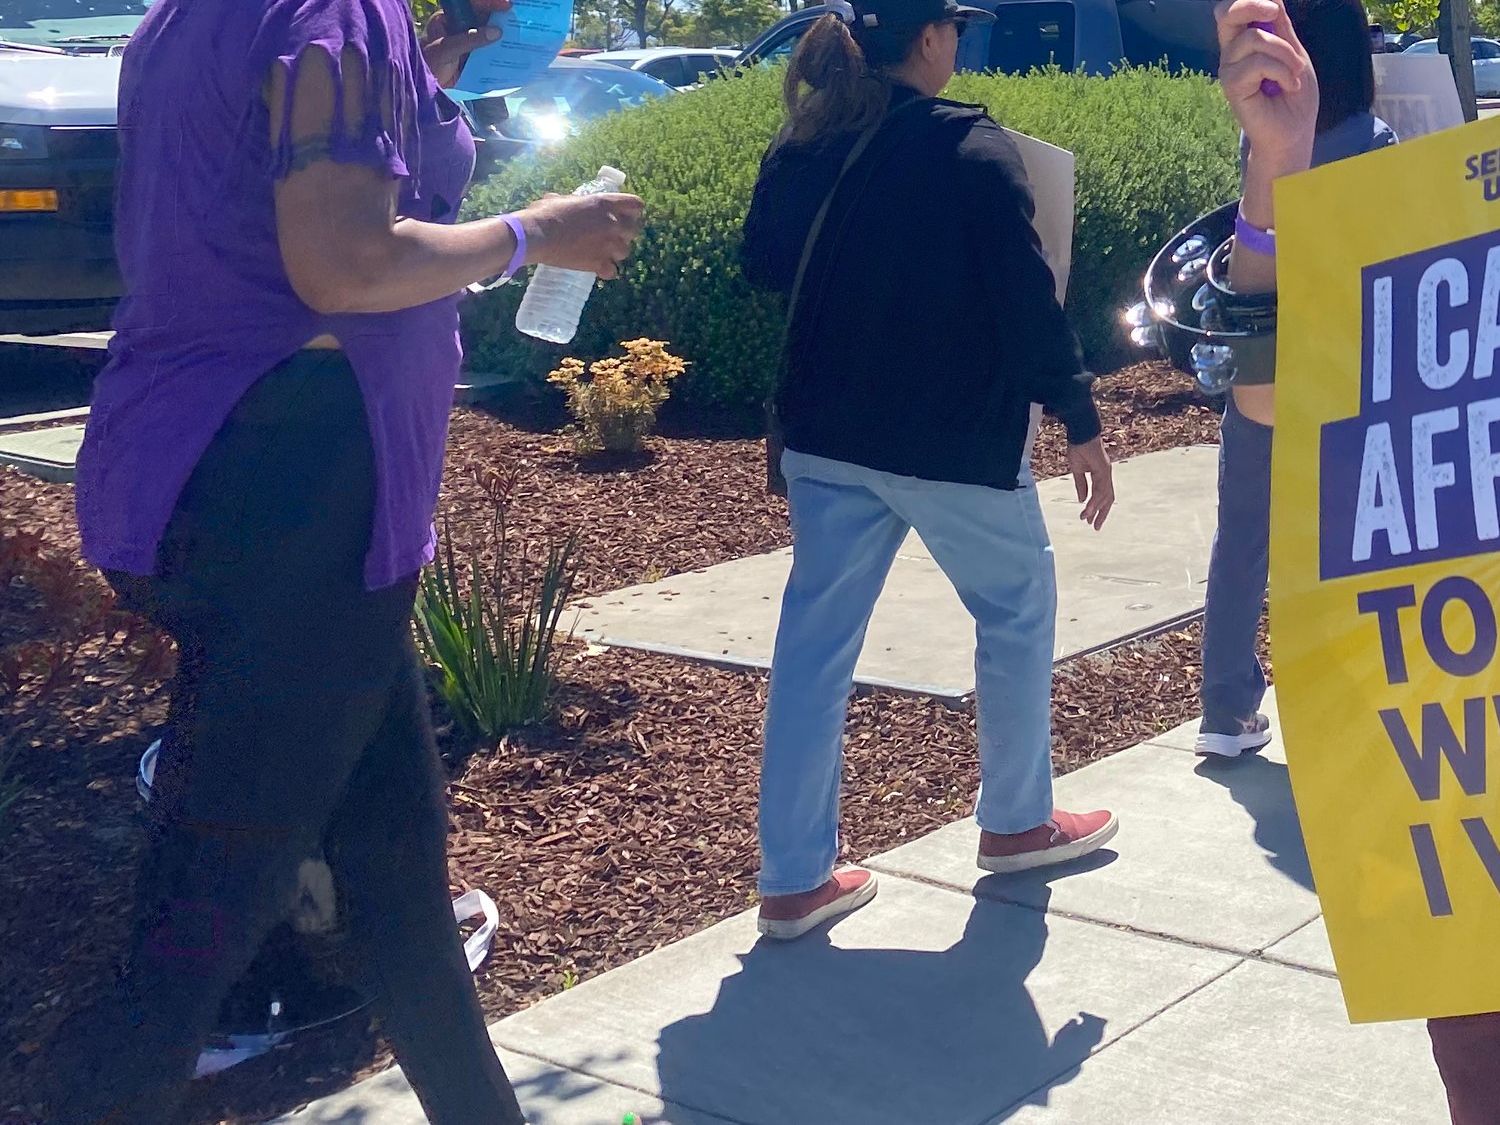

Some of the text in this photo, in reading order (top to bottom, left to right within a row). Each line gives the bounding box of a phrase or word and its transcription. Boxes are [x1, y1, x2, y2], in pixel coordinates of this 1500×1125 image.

[1372, 276, 1393, 403] I
[1357, 575, 1498, 685] TO
[1409, 823, 1454, 917] I
